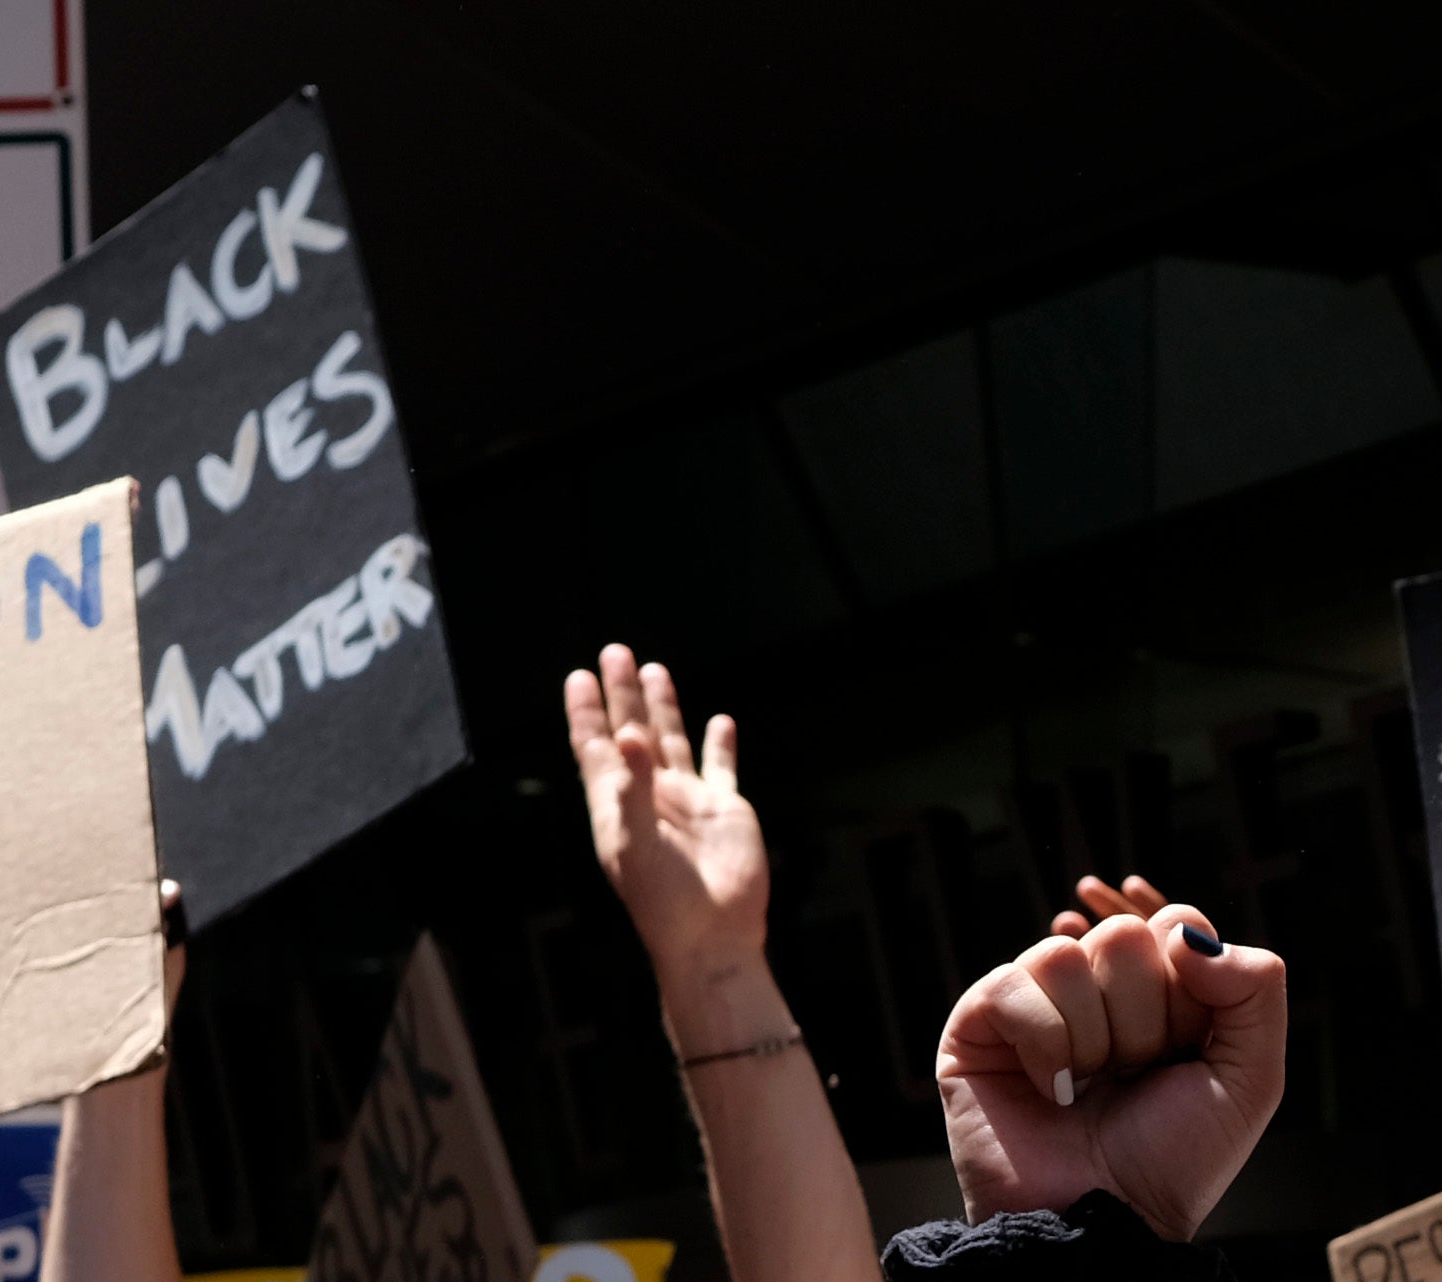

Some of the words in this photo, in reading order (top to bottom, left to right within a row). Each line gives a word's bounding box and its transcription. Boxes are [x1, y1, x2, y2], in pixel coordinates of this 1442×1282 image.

[6, 151, 349, 462] BLACK
[138, 330, 397, 598] IVES
[146, 532, 438, 782] MATTER
